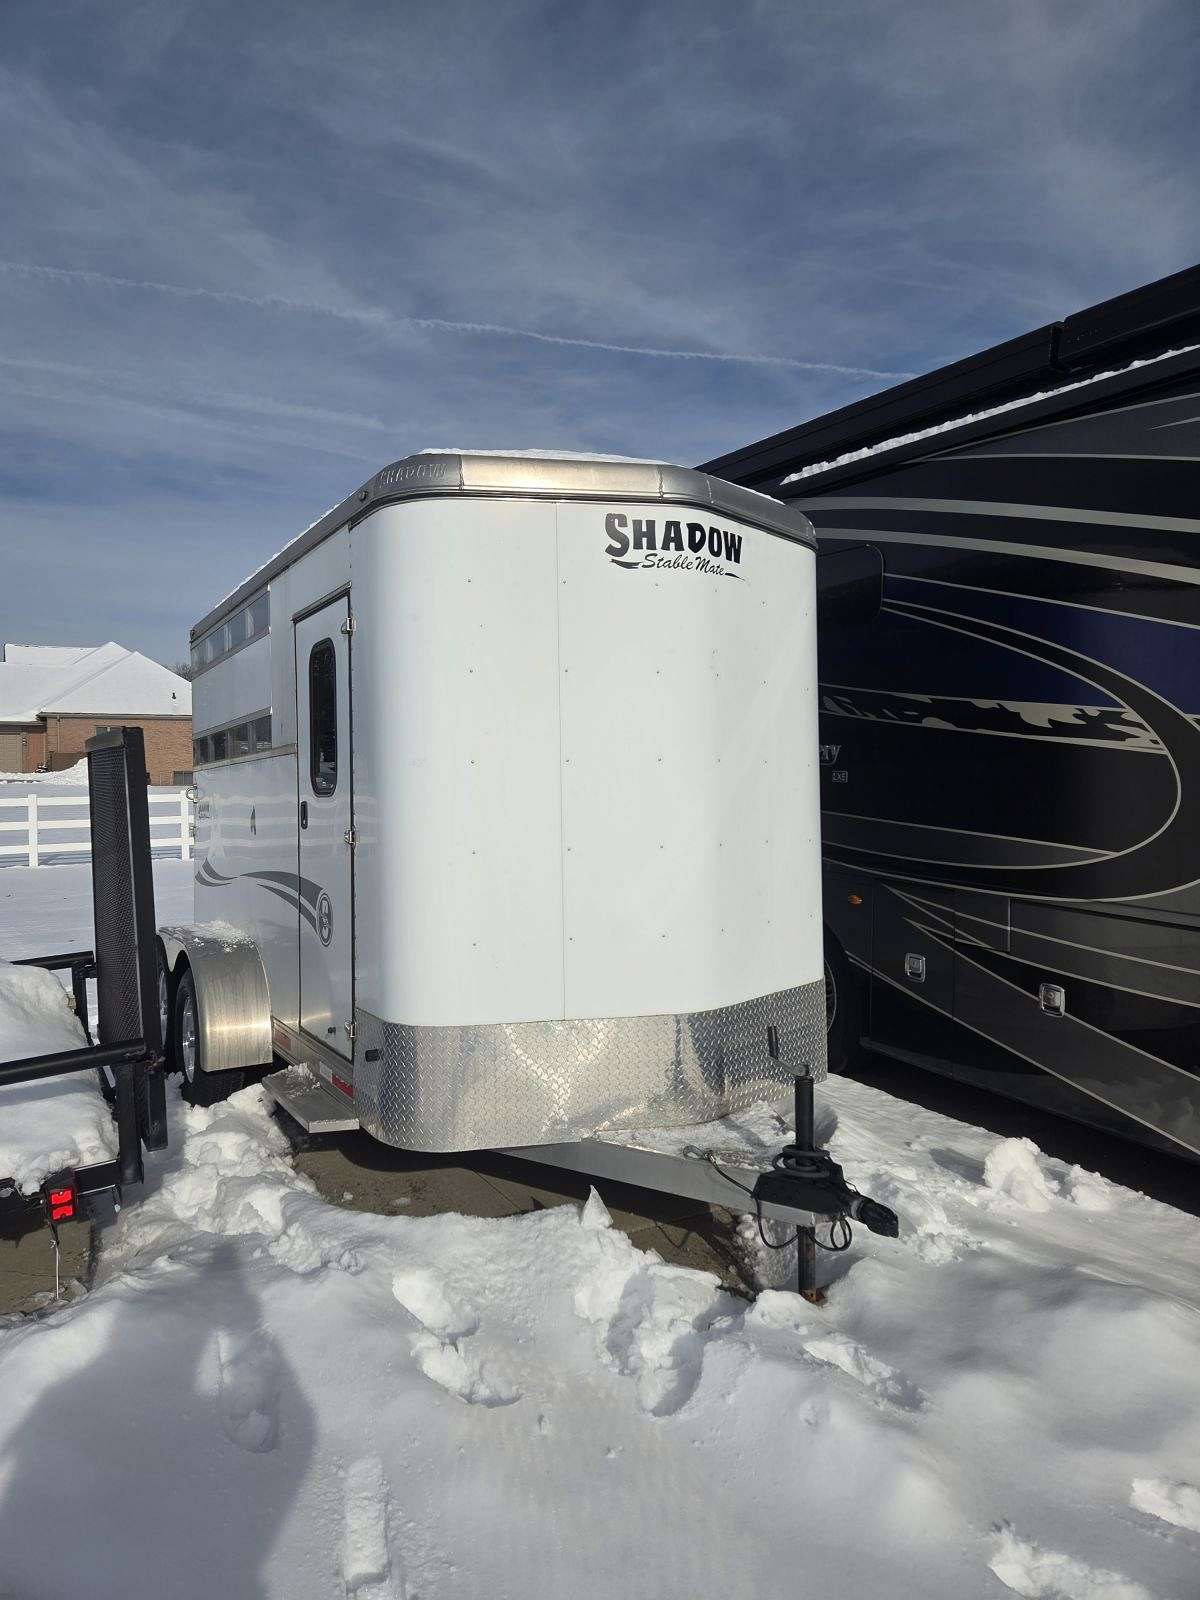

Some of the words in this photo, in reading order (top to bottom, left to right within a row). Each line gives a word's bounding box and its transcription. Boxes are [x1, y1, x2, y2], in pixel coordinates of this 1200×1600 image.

[605, 512, 743, 564] SHADOW
[641, 552, 693, 569] Stable
[694, 556, 725, 576] Mate
